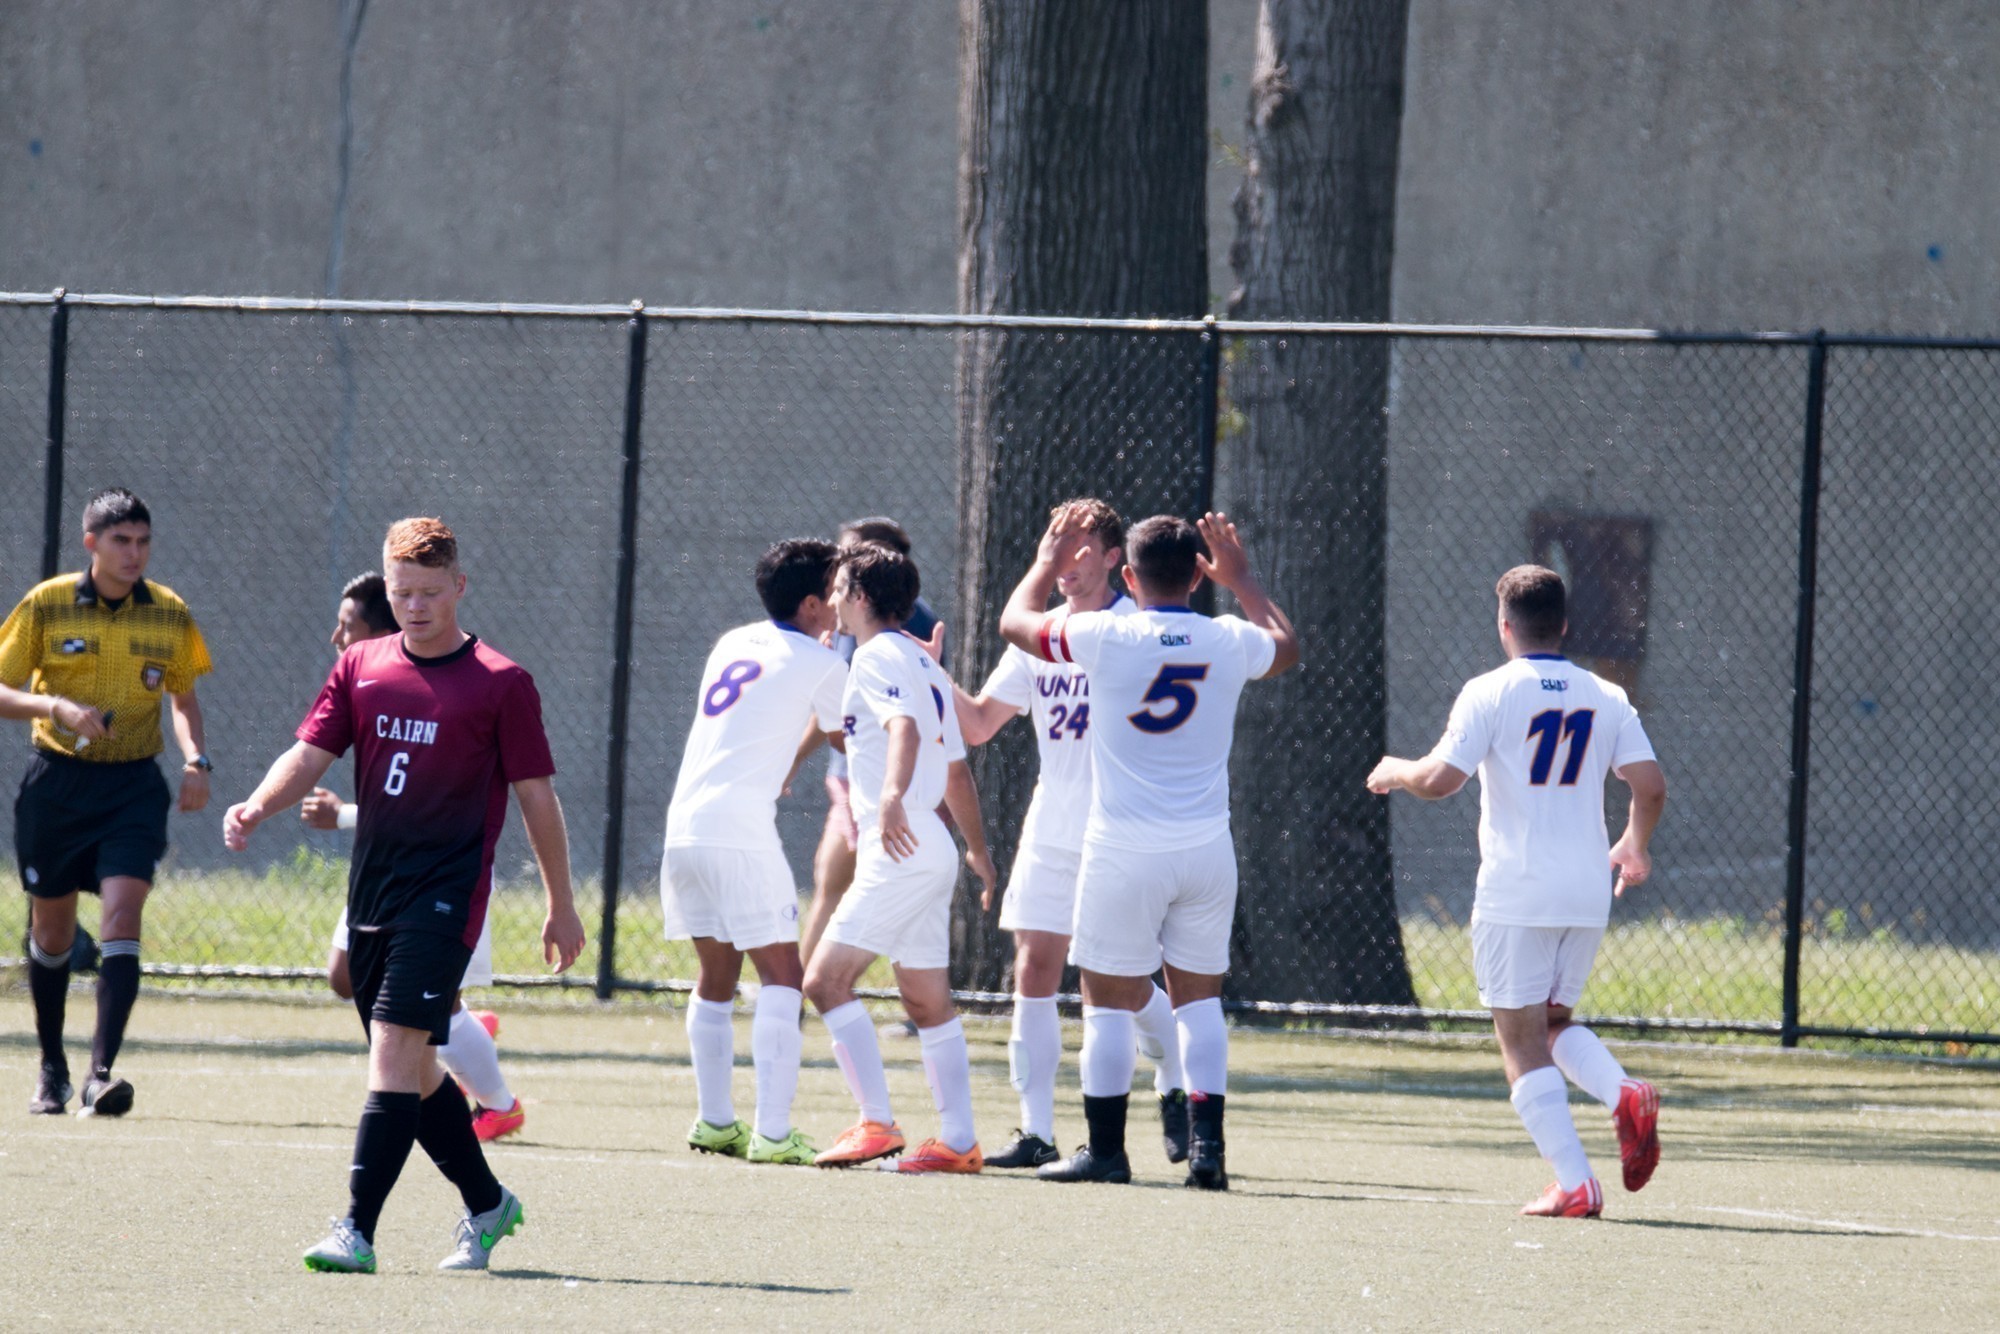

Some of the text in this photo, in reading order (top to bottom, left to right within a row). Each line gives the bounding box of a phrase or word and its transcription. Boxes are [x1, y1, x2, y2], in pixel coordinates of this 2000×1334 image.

[703, 659, 763, 718] 8
[1037, 673, 1089, 697] UNT
[1127, 662, 1211, 735] 5
[376, 714, 439, 744] CAIRN
[1049, 703, 1089, 740] 24
[1525, 708, 1597, 786] 11
[384, 752, 409, 796] 6
